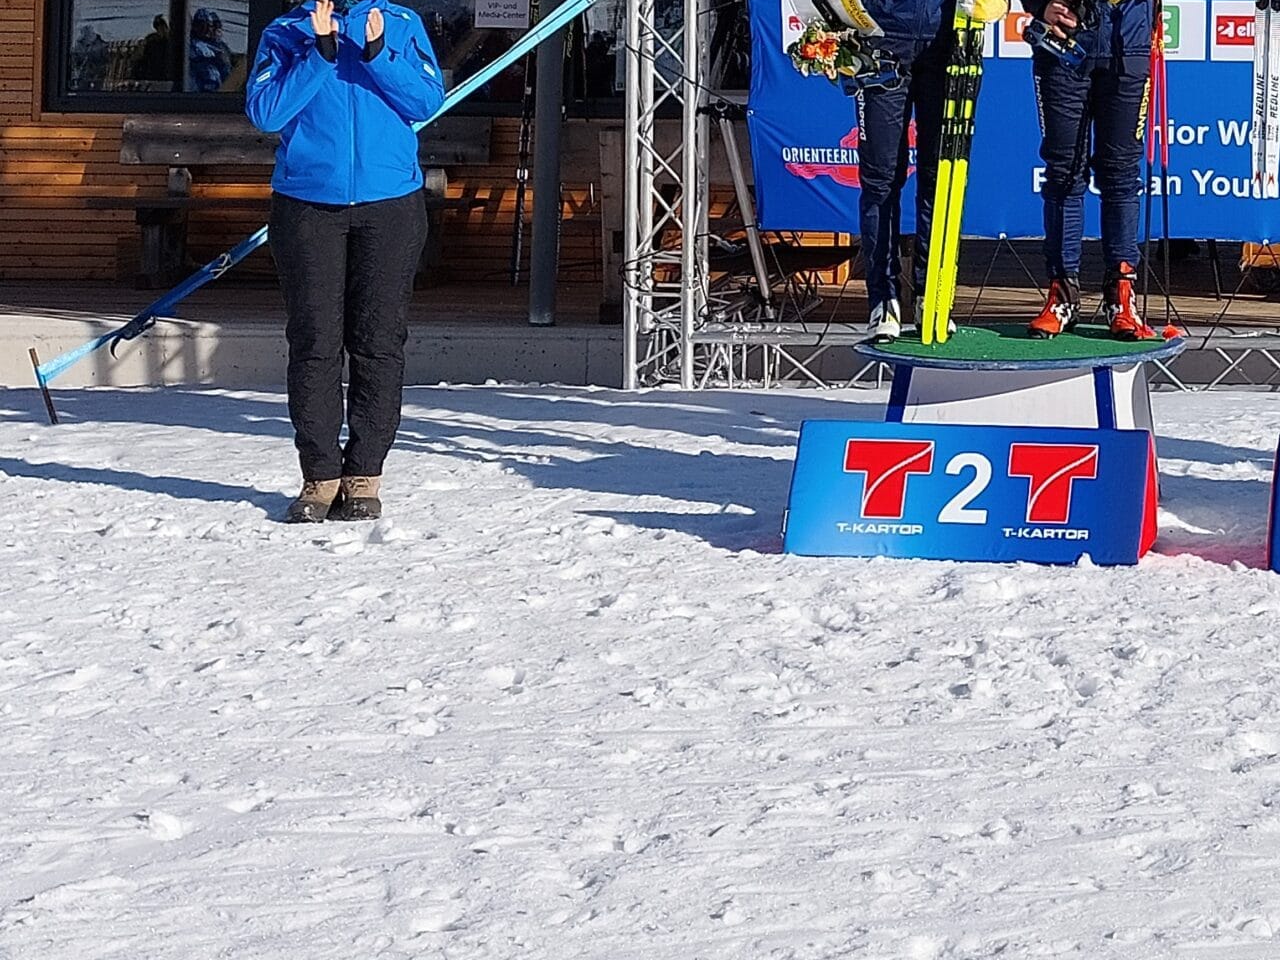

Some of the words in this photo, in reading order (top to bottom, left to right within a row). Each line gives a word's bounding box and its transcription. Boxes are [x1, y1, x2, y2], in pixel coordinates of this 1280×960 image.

[1255, 73, 1265, 117] REDLINE
[1269, 75, 1280, 119] REDLINE
[783, 146, 859, 164] ORIENTEERIN
[938, 452, 992, 524] 2
[836, 522, 923, 535] T-KARTOR
[1002, 527, 1089, 540] T-KARTOR
